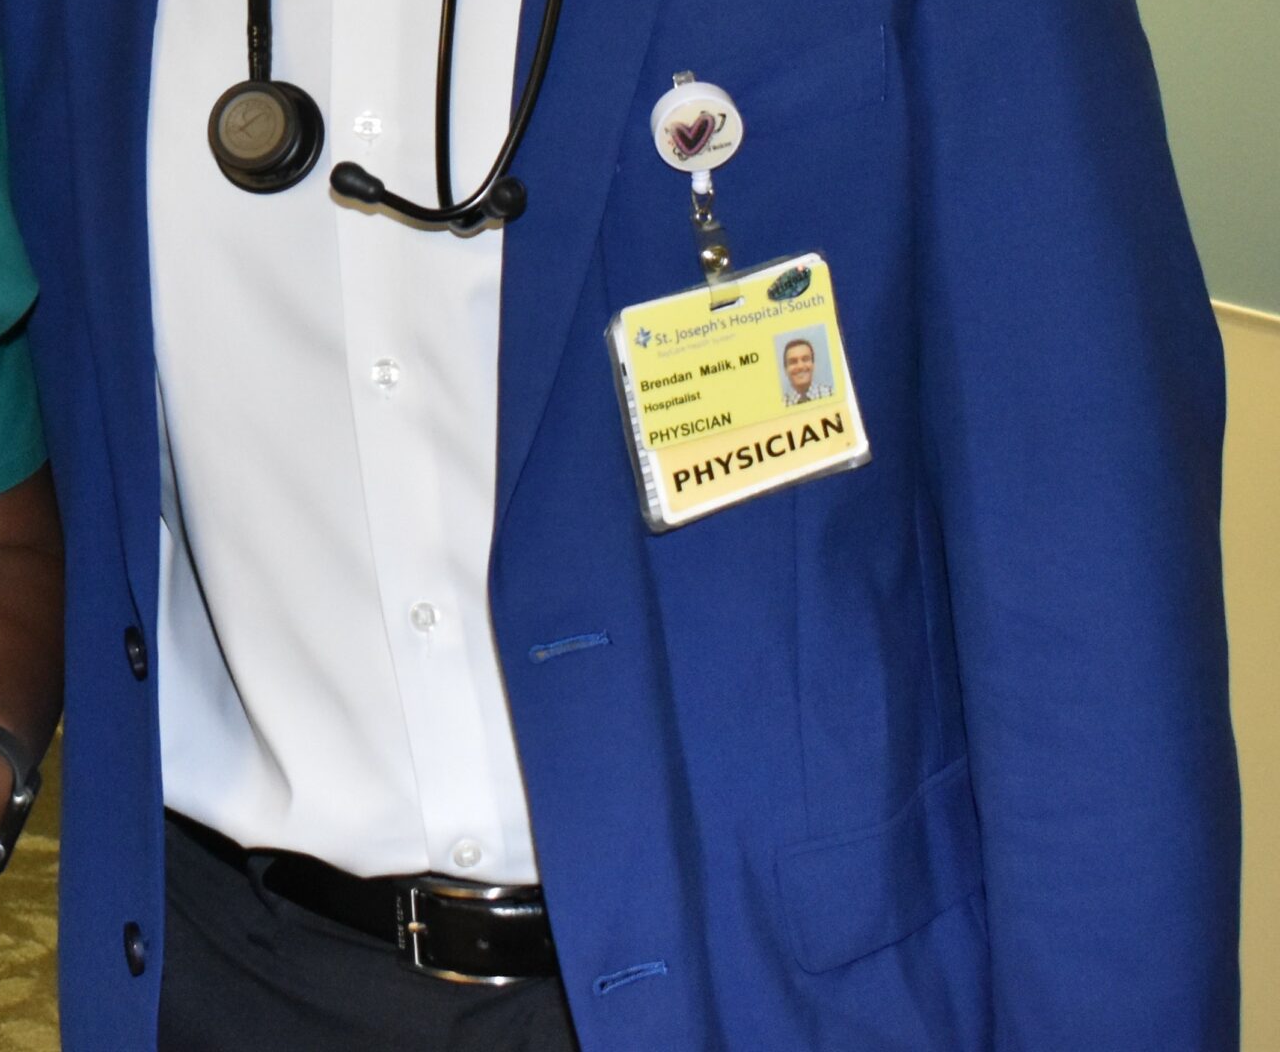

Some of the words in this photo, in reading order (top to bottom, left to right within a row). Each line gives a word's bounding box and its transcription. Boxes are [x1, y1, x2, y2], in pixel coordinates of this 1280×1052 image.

[654, 332, 672, 346] St.
[675, 318, 727, 342] Joseph's
[729, 294, 825, 327] Hospital-South
[640, 370, 693, 392] Brendan
[699, 359, 736, 377] Malik,
[739, 352, 759, 367] MD
[644, 391, 701, 414] Hospitalist
[649, 412, 732, 445] PHYSICIAN
[672, 412, 844, 493] PHYSICIAN
